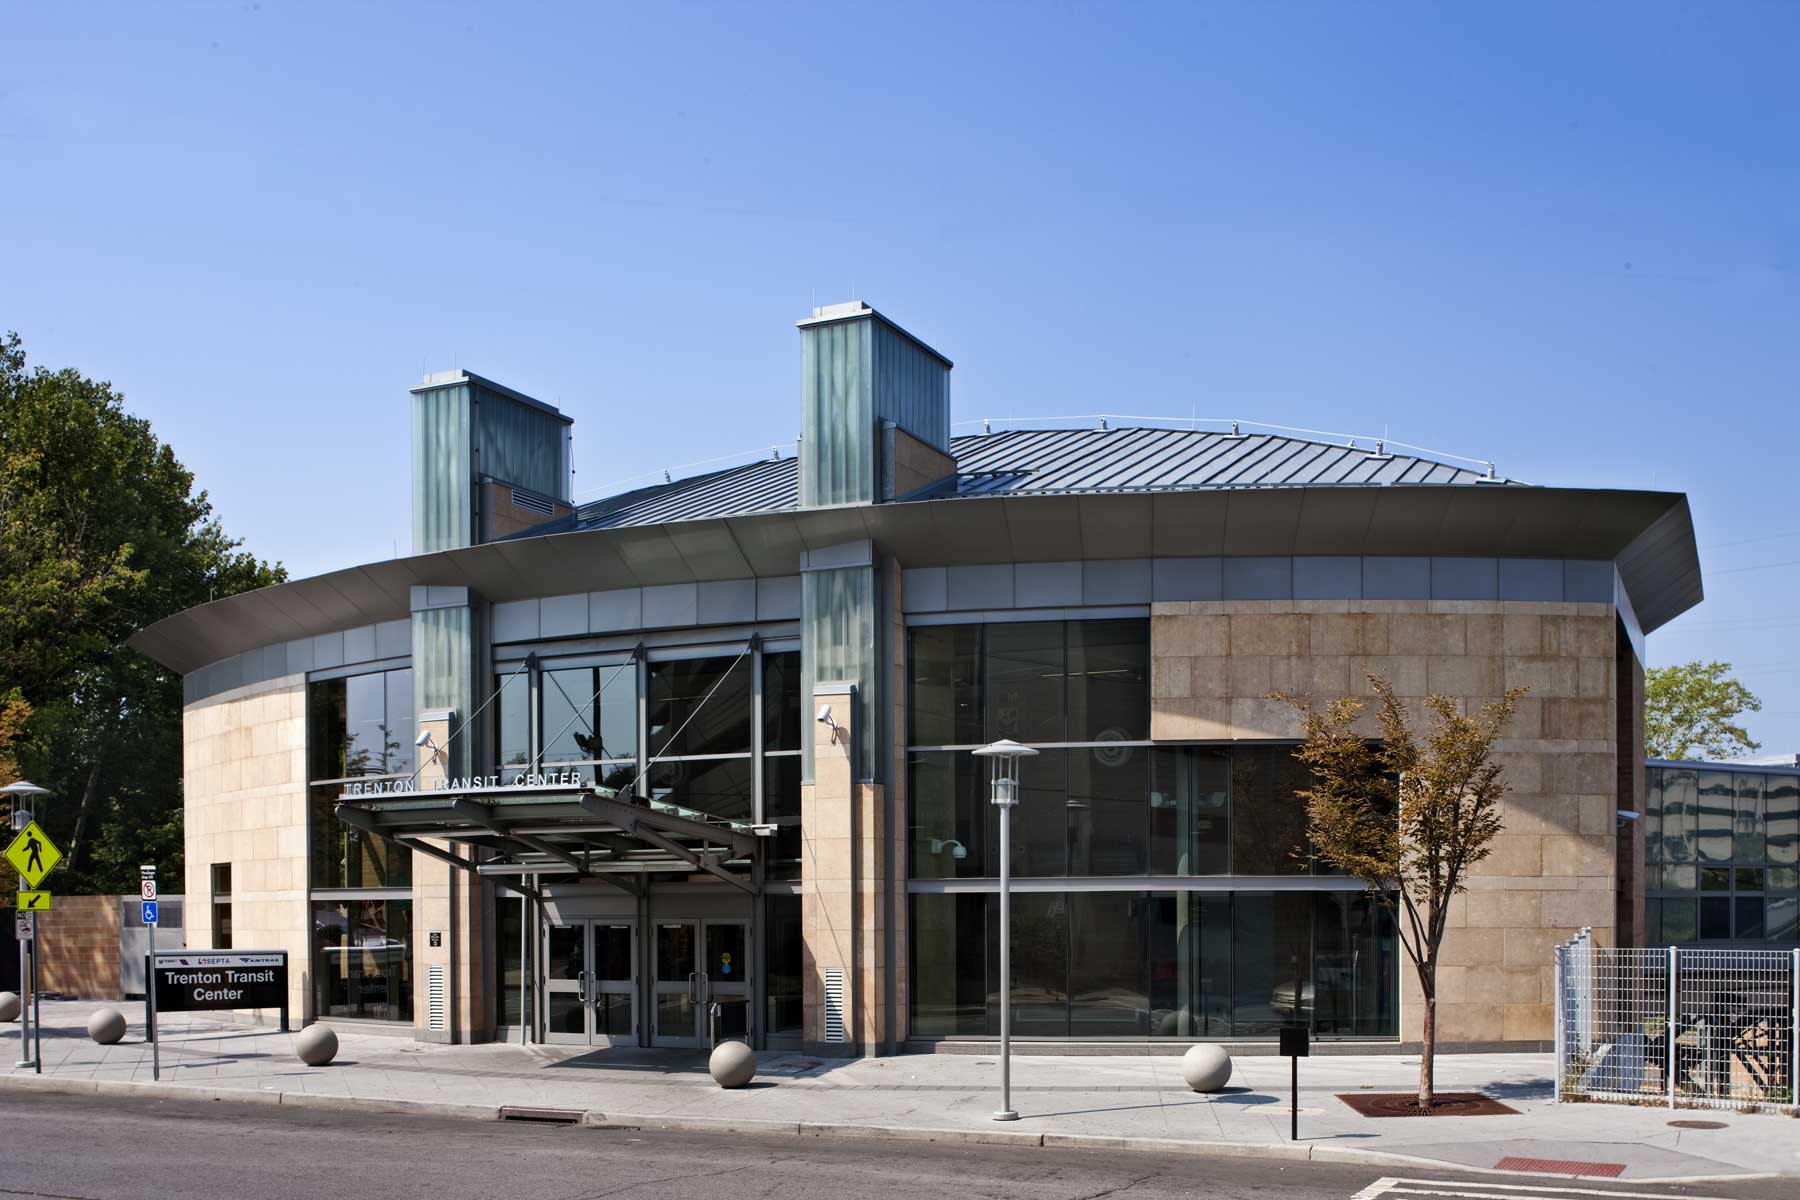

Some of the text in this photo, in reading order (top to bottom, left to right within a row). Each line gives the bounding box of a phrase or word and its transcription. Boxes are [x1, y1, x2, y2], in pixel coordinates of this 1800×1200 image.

[344, 772, 581, 796] TRENTON TRANSIT CENTER
[165, 969, 274, 985] Trenton Transit
[193, 987, 243, 1001] Center
